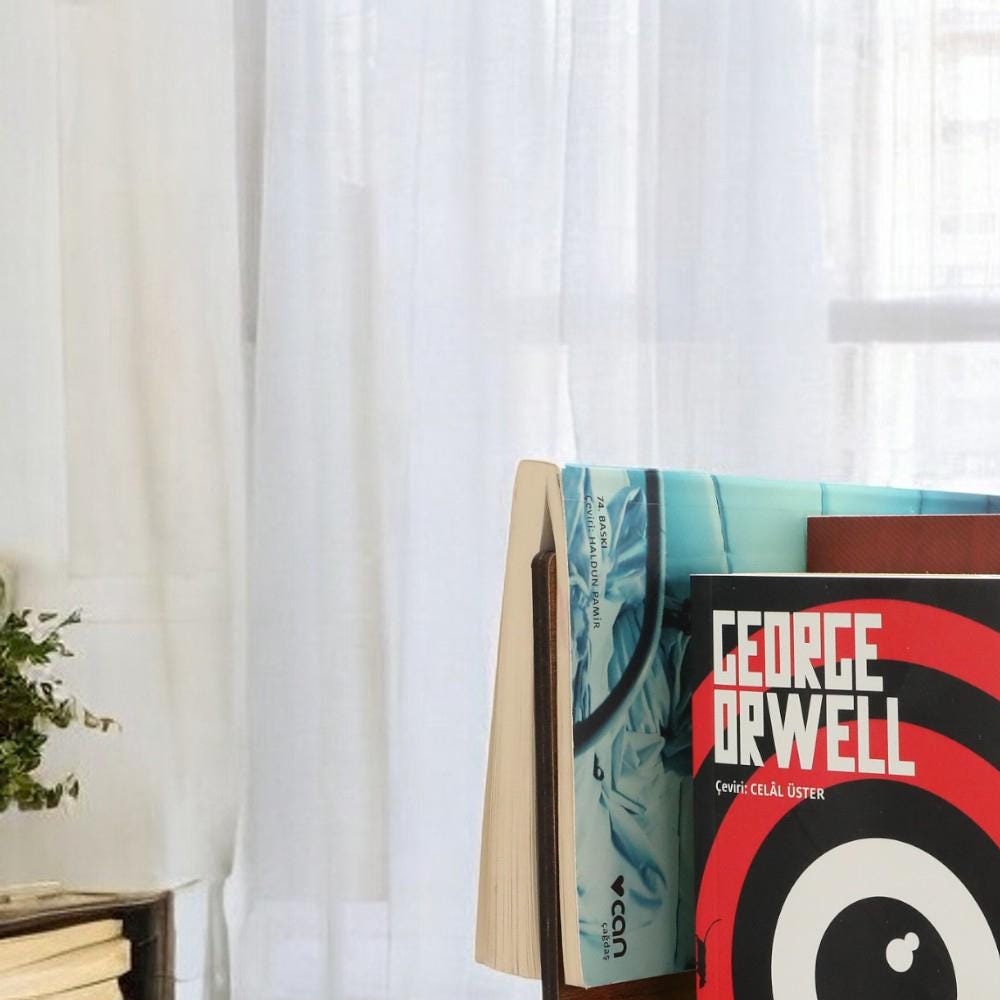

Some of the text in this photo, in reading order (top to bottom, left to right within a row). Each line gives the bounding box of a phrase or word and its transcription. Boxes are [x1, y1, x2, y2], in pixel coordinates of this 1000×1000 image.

[589, 537, 600, 587] HALDUN
[713, 610, 884, 692] GEORGE
[714, 689, 916, 777] ORWELL
[715, 779, 825, 801] Çeviri: CELÂL ÜSTER
[611, 899, 628, 958] can
